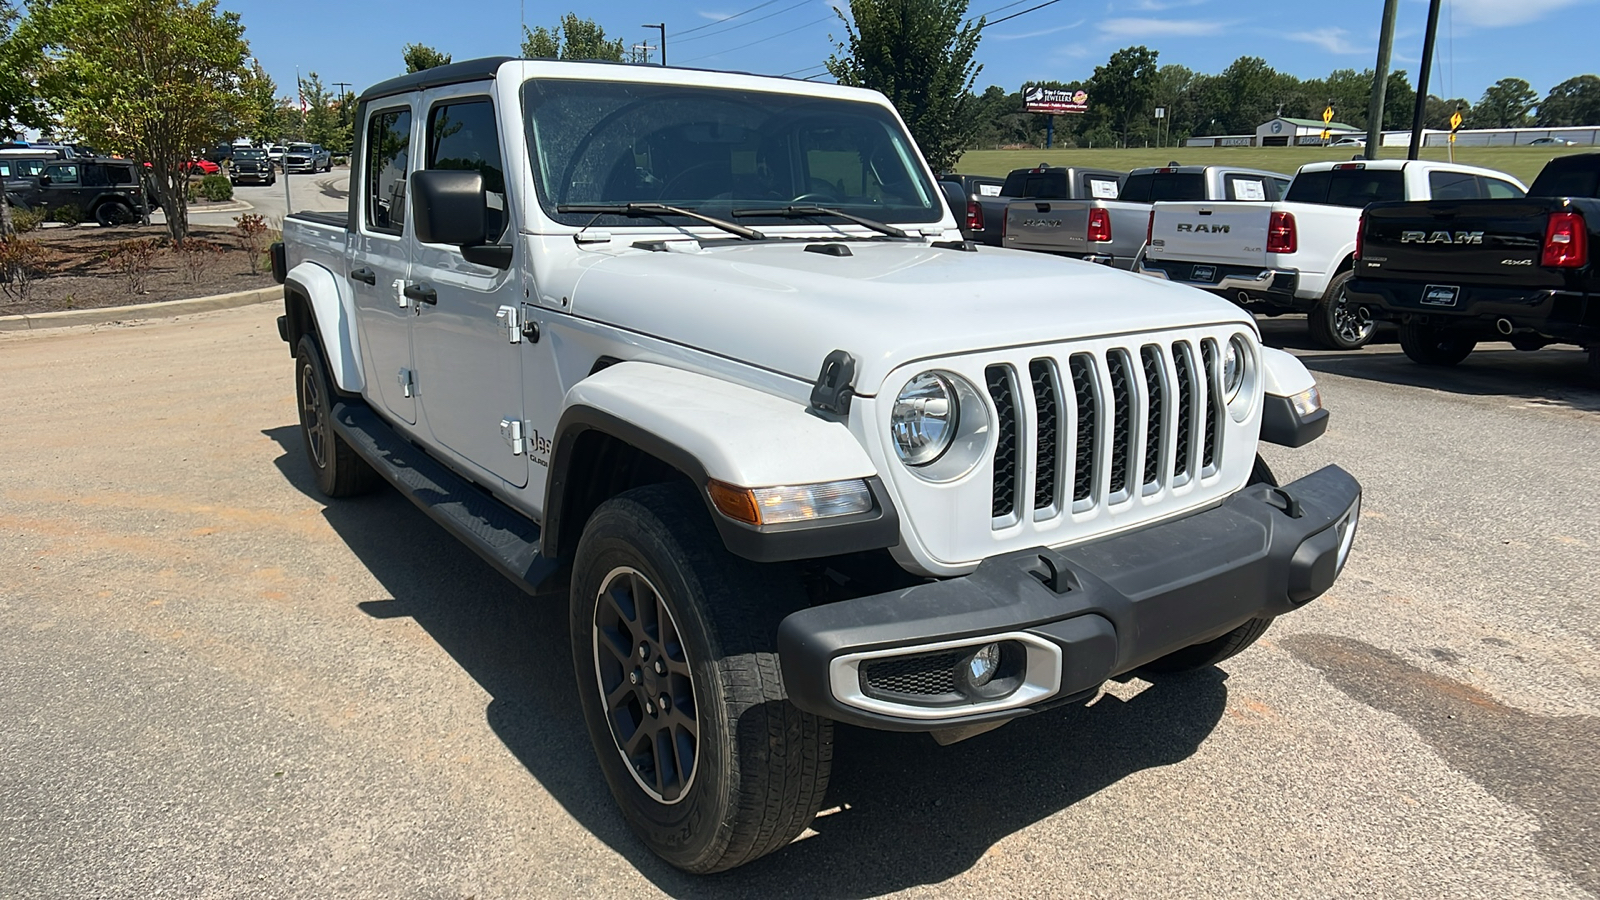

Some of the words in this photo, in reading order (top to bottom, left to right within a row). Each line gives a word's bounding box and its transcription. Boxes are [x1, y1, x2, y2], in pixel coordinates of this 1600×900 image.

[1023, 219, 1062, 228] RAM
[1177, 223, 1231, 233] RAM
[1401, 231, 1485, 244] RAM
[530, 429, 552, 454] Jee
[530, 454, 548, 468] GLADI
